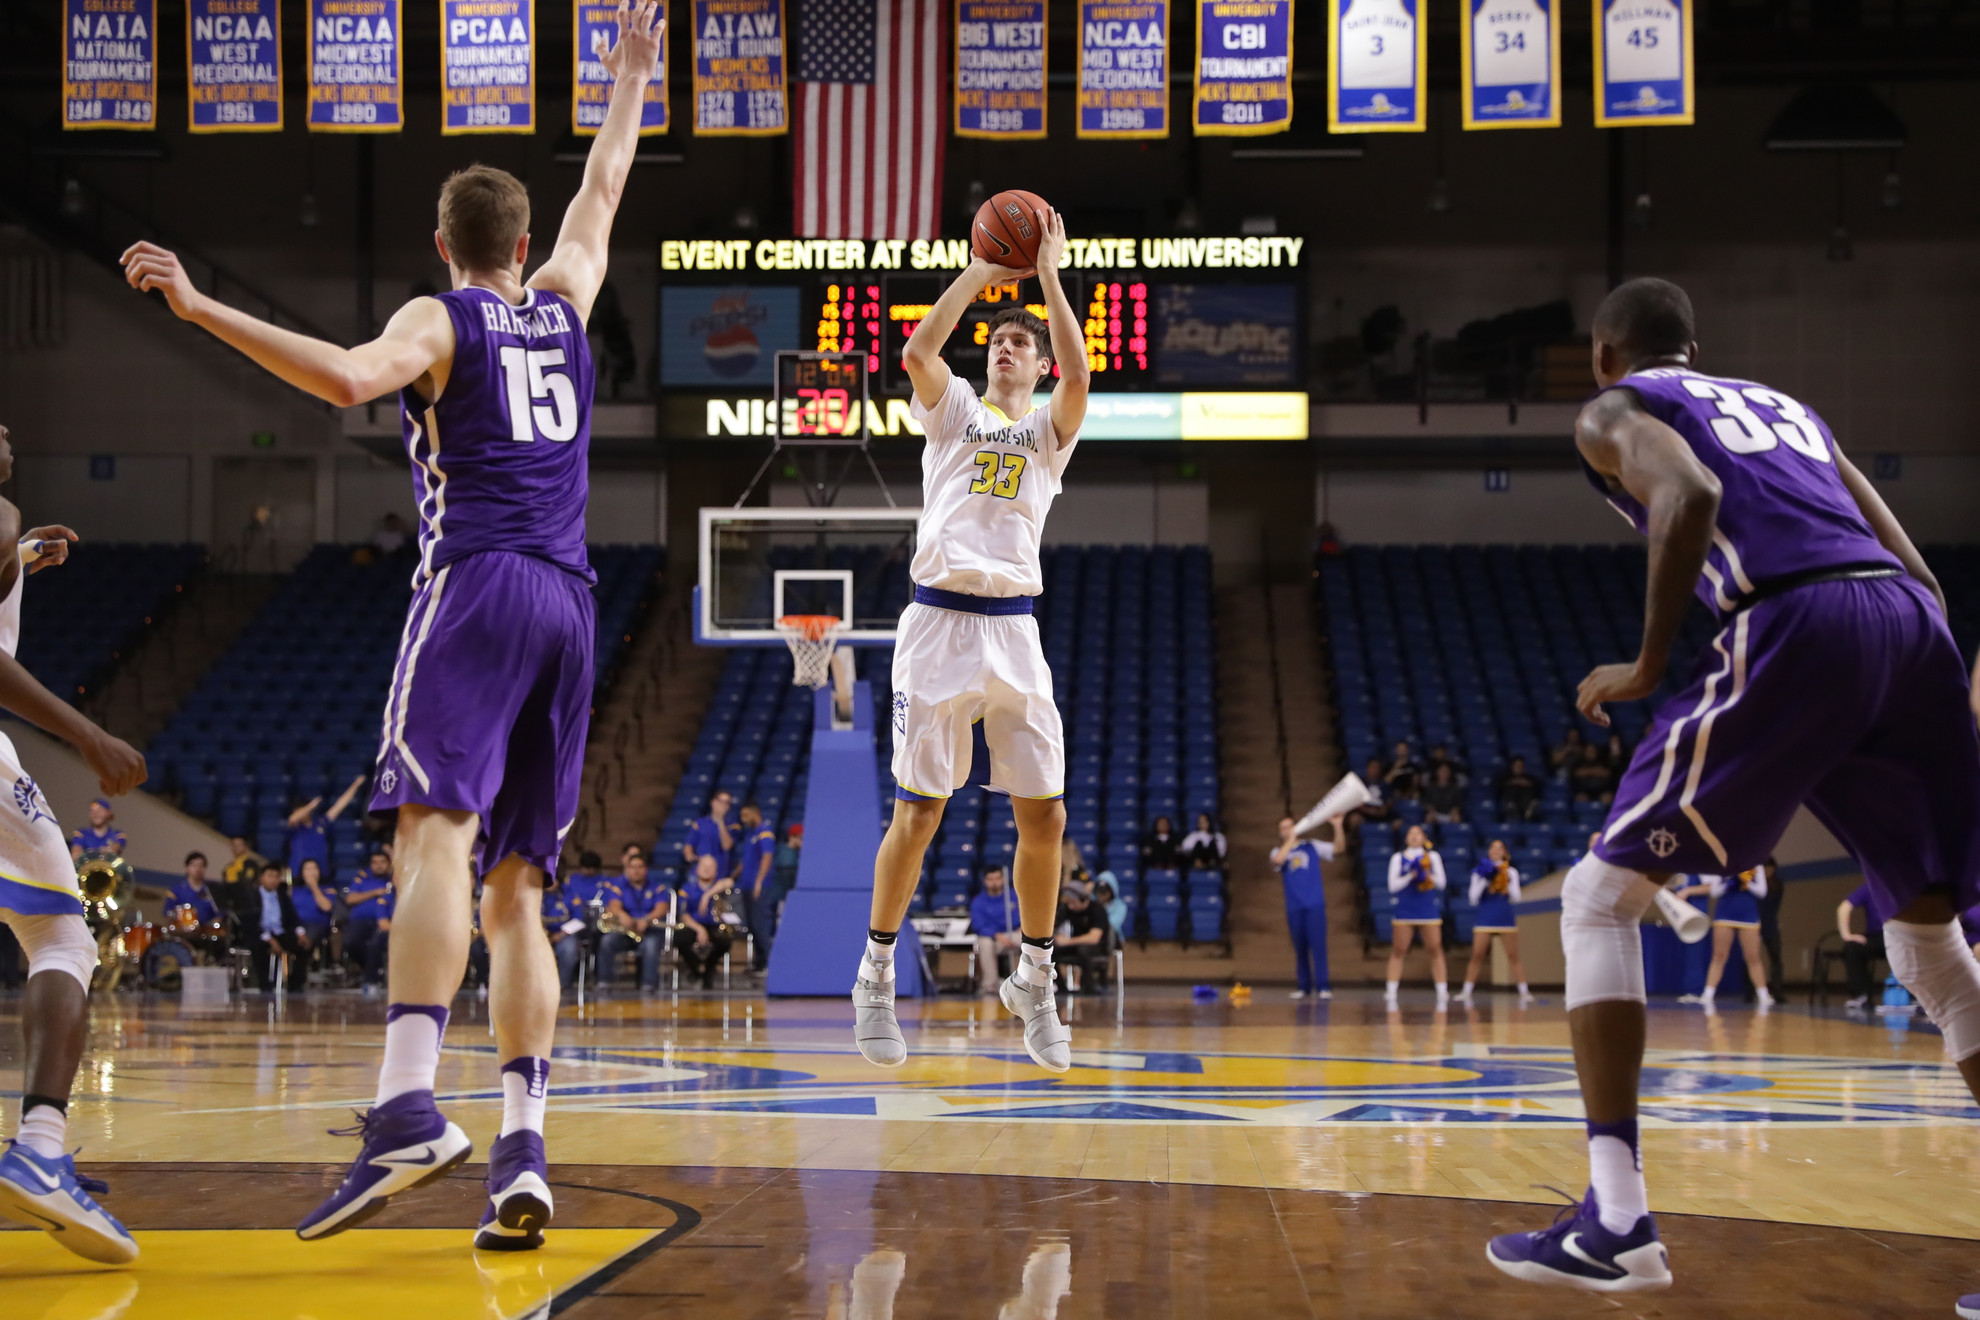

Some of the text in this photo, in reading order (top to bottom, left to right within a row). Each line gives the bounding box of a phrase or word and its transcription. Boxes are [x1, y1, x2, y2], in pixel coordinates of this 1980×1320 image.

[72, 15, 148, 40] NAIA
[195, 16, 273, 41] NCAA
[316, 17, 394, 42] NCAA
[450, 18, 528, 44] PCAA
[702, 14, 776, 39] AIAW
[959, 22, 1045, 48] BIG WEST
[1223, 24, 1266, 50] CBI
[696, 38, 784, 59] FIRST ROUND
[1370, 35, 1384, 57] 3
[1495, 31, 1526, 54] 34
[1627, 28, 1659, 50] 45
[75, 41, 145, 61] NATIONAL
[210, 43, 260, 63] WEST
[316, 44, 395, 64] MIDWEST
[446, 45, 531, 67] TOURNAMENT
[959, 50, 1044, 70] TOURNAMENT
[1082, 50, 1165, 70] MID WEST
[67, 61, 152, 81] TOURNAMENT
[194, 62, 277, 84] REGIONAL
[313, 63, 396, 84] REGIONAL
[448, 66, 528, 87] CHAMPIONS
[1082, 69, 1165, 90] REGIONAL
[1201, 57, 1289, 80] TOURNAMENT
[698, 74, 782, 93] BASKETBALL
[959, 70, 1044, 90] CHAMPIONS
[661, 240, 752, 270] EVENT
[755, 240, 867, 270] CENTER
[870, 240, 908, 269] AT
[910, 240, 968, 270] SAN
[1142, 237, 1304, 269] UNIVERSITY
[500, 346, 578, 442] 15
[706, 399, 926, 436] NISSAN
[1680, 379, 1832, 464] 33
[968, 450, 1027, 500] 33
